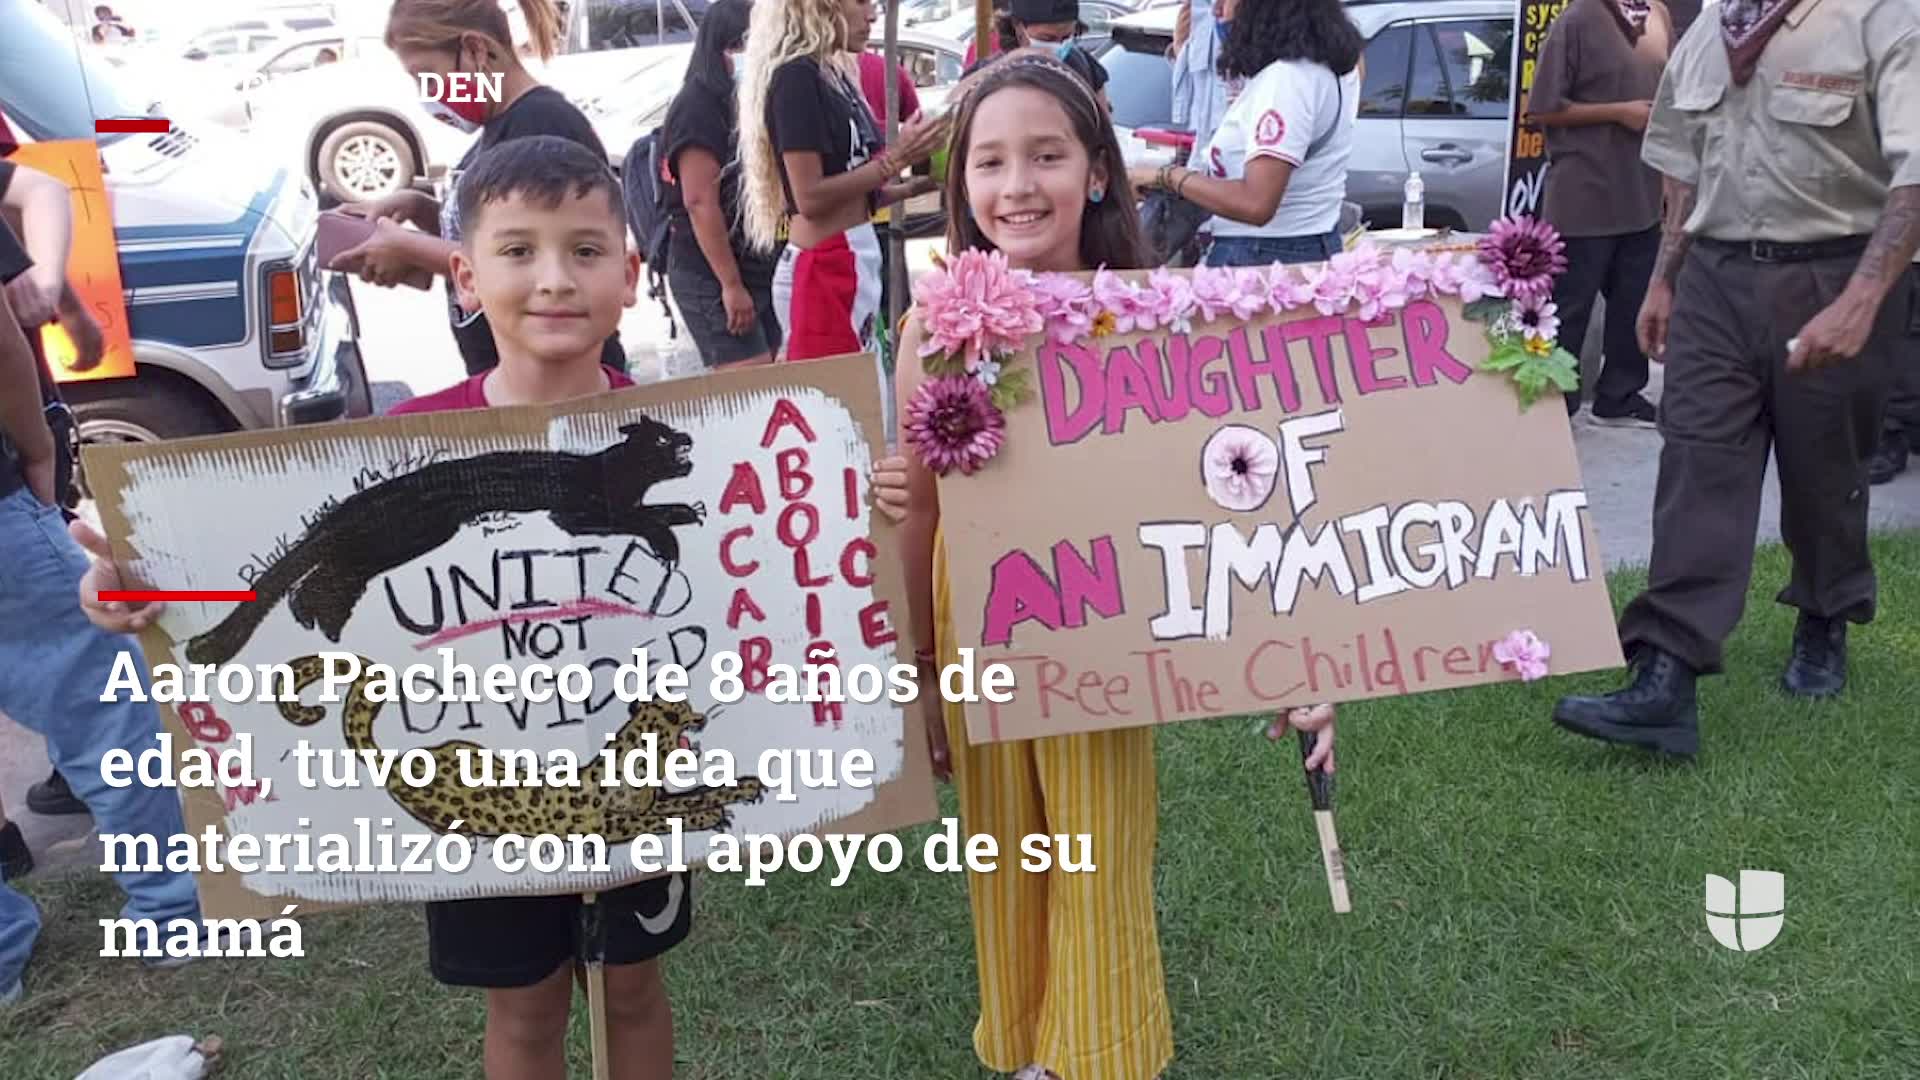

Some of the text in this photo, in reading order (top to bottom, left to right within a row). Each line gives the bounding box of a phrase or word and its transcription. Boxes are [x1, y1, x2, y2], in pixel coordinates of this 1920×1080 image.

[1038, 301, 1473, 446] DAUGHTER
[1201, 406, 1344, 516] OF
[384, 539, 693, 636] UNITED
[719, 461, 776, 693] ACAB
[840, 467, 899, 649] ICE
[981, 489, 1592, 647] AN IMMIGRANT
[501, 614, 592, 660] NOT
[1129, 651, 1221, 721] The
